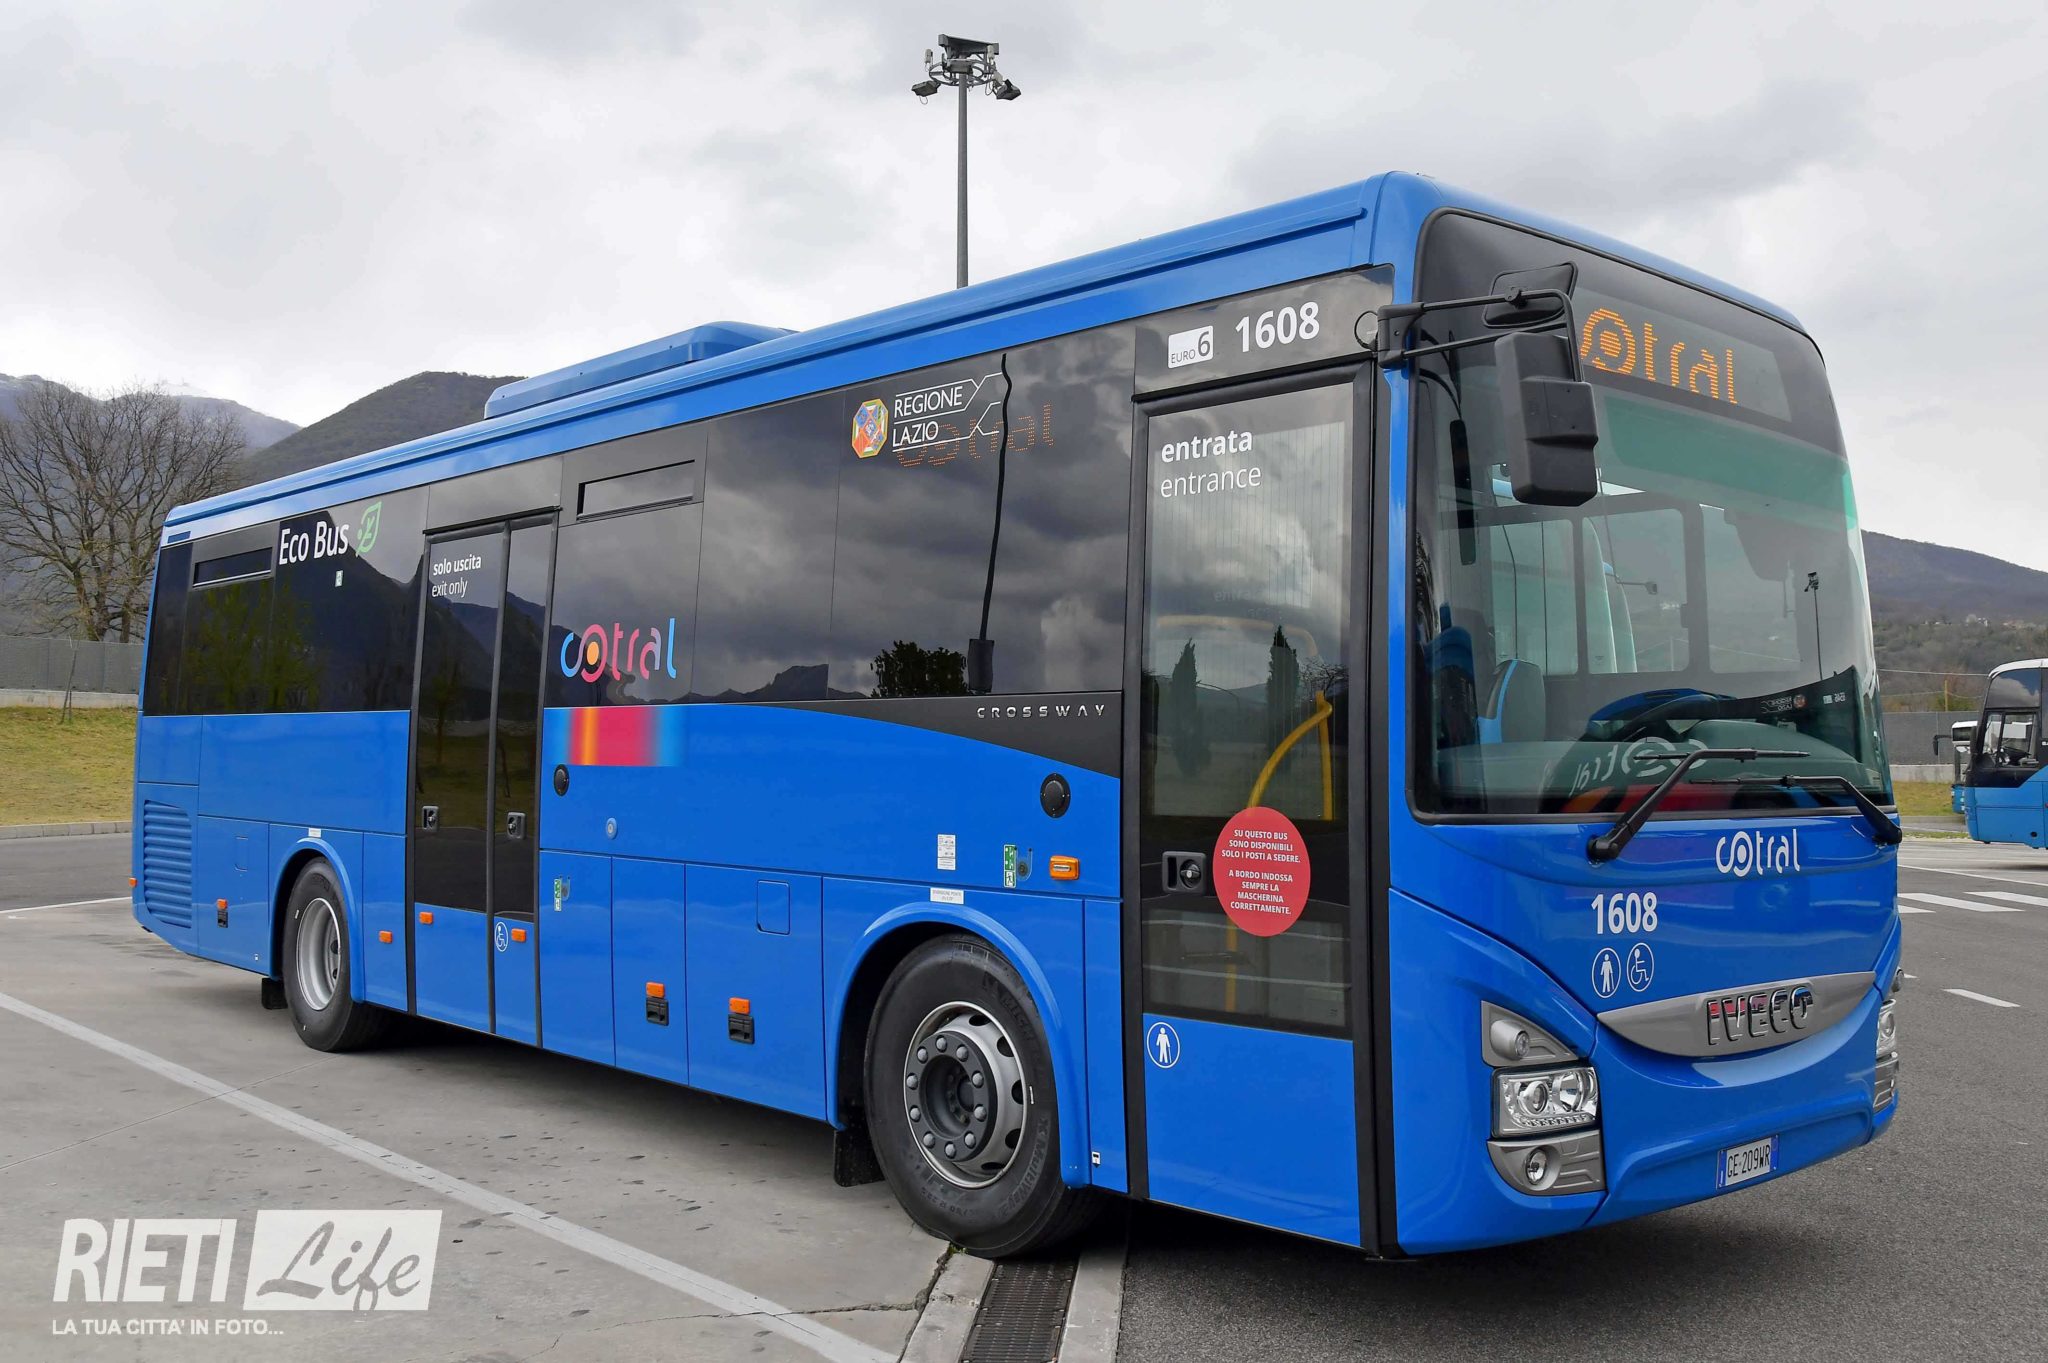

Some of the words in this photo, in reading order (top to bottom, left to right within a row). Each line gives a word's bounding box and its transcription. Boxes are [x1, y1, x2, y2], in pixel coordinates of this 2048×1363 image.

[1235, 301, 1320, 353] 1608
[1171, 349, 1196, 364] EURO
[1197, 331, 1211, 357] 6
[1580, 308, 1738, 405] otral
[893, 385, 963, 418] REGIONE
[892, 421, 939, 447] LAZIO
[1161, 430, 1253, 463] entrata
[1160, 466, 1262, 498] entrance
[278, 528, 309, 565] Eco
[313, 520, 350, 559] Bus
[433, 558, 452, 576] solo
[453, 553, 482, 573] uscita
[431, 580, 448, 598] exit
[448, 577, 468, 598] only
[560, 617, 677, 683] cotral
[976, 704, 1105, 719] CROSSWAY
[1229, 840, 1249, 848] SONO
[1251, 842, 1293, 851] DISPONIBILI
[1234, 829, 1244, 838] SU
[1245, 830, 1272, 840] QUESTO
[1274, 832, 1288, 840] BUS
[1221, 850, 1240, 858] SOLO
[1245, 851, 1265, 860] POSTI
[1273, 854, 1300, 863] SEDERE.
[1715, 828, 1801, 877] cotral
[1228, 869, 1234, 877] A
[1235, 870, 1260, 879] BORDO
[1261, 872, 1293, 882] INDOSSA
[1241, 881, 1268, 891] SEMPRE
[1230, 901, 1291, 915] CORRETTAMENTE.
[1237, 891, 1284, 903] MASCHERINA
[1591, 891, 1658, 935] 1608
[1707, 986, 1814, 1046] IVECO
